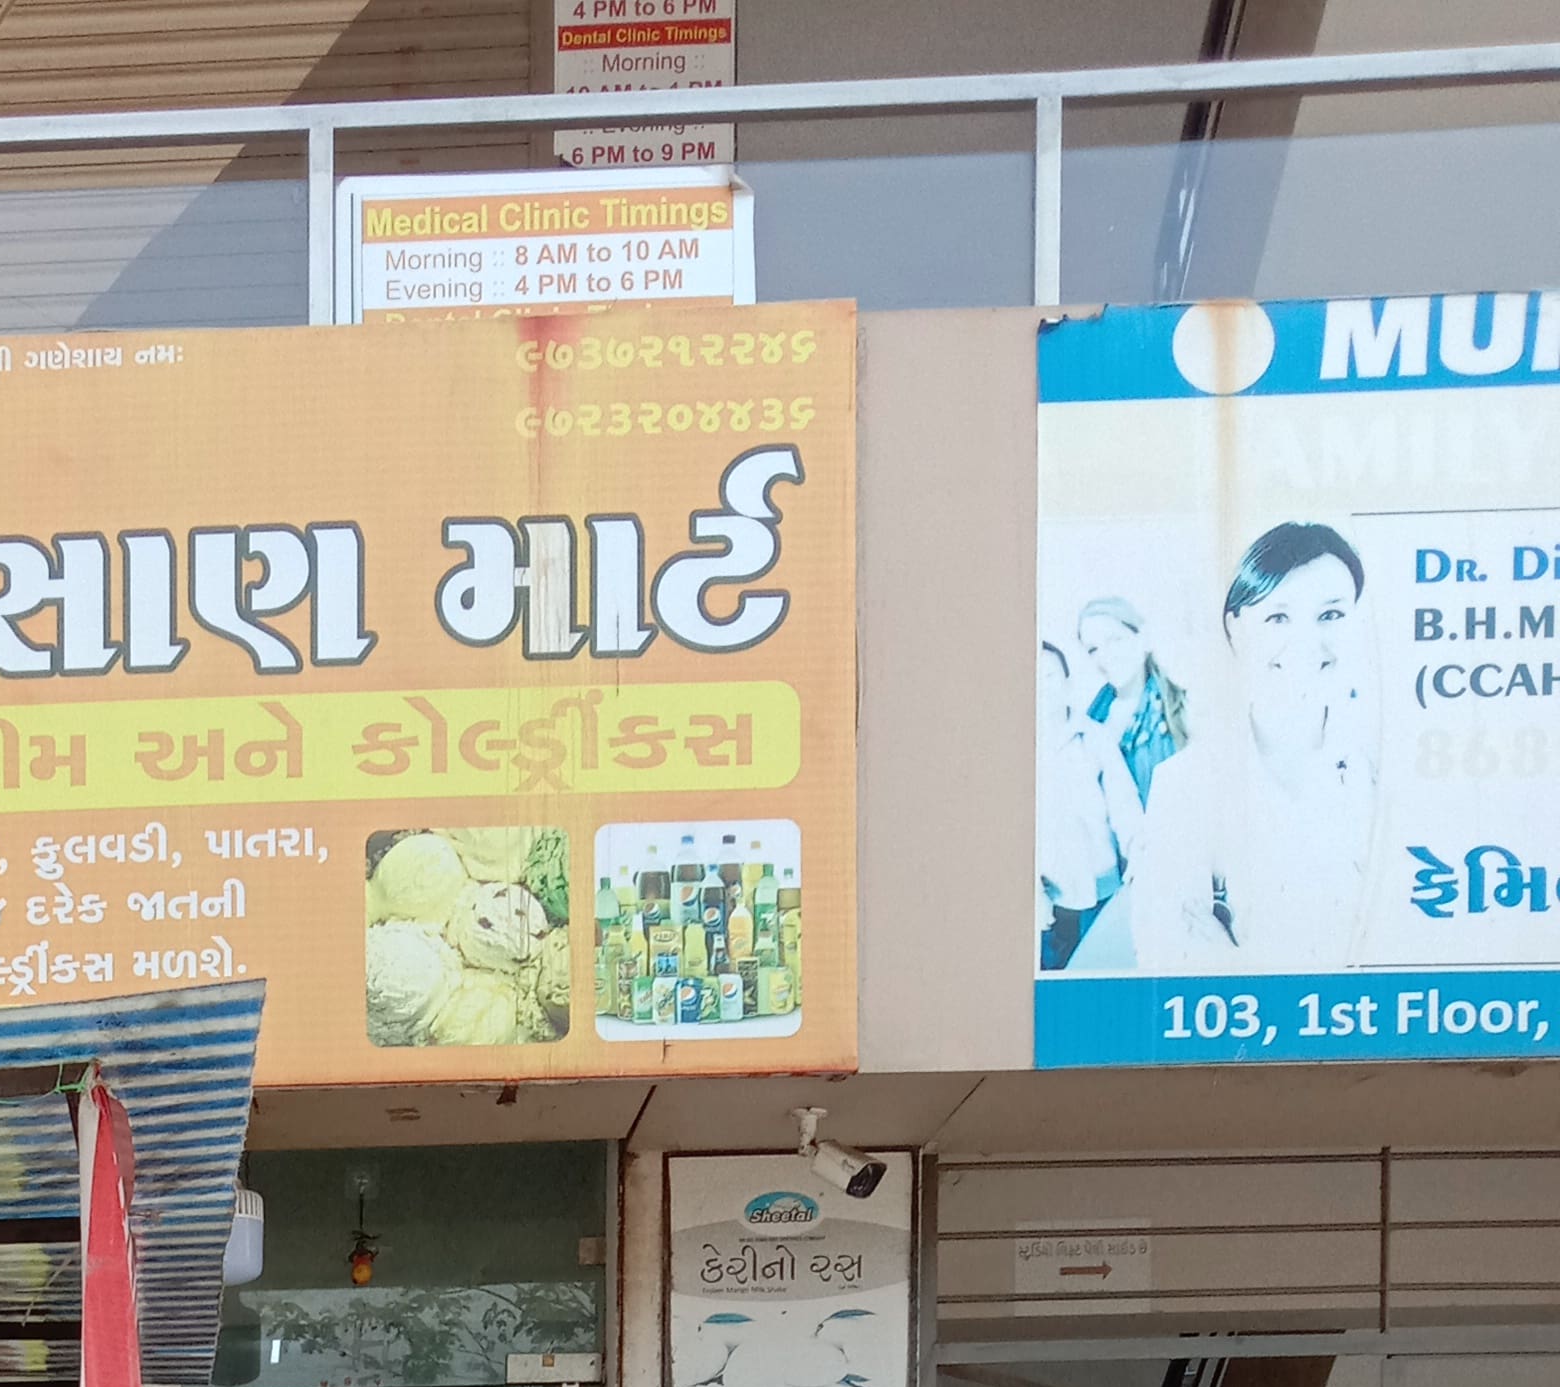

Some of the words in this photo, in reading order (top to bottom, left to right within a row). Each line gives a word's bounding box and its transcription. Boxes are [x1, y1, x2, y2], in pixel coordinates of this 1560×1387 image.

[573, 1, 586, 19] 4
[594, 0, 626, 18] PM
[635, 0, 655, 16] to
[663, 0, 675, 15] 6
[683, 0, 716, 14] PM
[561, 29, 611, 46] Dental
[616, 27, 659, 43] Clinic
[665, 25, 726, 42] Timings
[602, 53, 685, 73] Morning
[572, 148, 583, 165] 6
[592, 145, 624, 164] PM
[632, 146, 653, 162] to
[662, 144, 673, 161] 9
[682, 141, 715, 160] PM
[366, 204, 488, 237] Medical
[498, 200, 590, 233] Clinic
[599, 197, 728, 230] Timings
[386, 249, 482, 273] Morning
[515, 245, 528, 266] 8
[536, 242, 578, 265] AM
[588, 243, 611, 263] to
[621, 241, 648, 261] 10
[658, 238, 700, 260] AM
[386, 279, 482, 303] Evening
[515, 275, 529, 296] 4
[540, 273, 577, 294] PM
[588, 274, 611, 292] to
[621, 272, 634, 291] 6
[644, 269, 683, 290] PM
[23, 341, 123, 371] ગણેશાય
[435, 444, 805, 660] માર્ટ
[134, 701, 304, 784] અને
[1406, 844, 1560, 919] ફેમિ
[26, 883, 107, 925] દરેક
[127, 878, 246, 921] જાતની
[1163, 992, 1279, 1047] 103,
[1298, 991, 1378, 1036] 1st
[1397, 988, 1550, 1040] Floor,
[750, 1206, 814, 1223] Sheetal
[700, 1243, 795, 1284] કેરીનો
[810, 1254, 862, 1282] રસ
